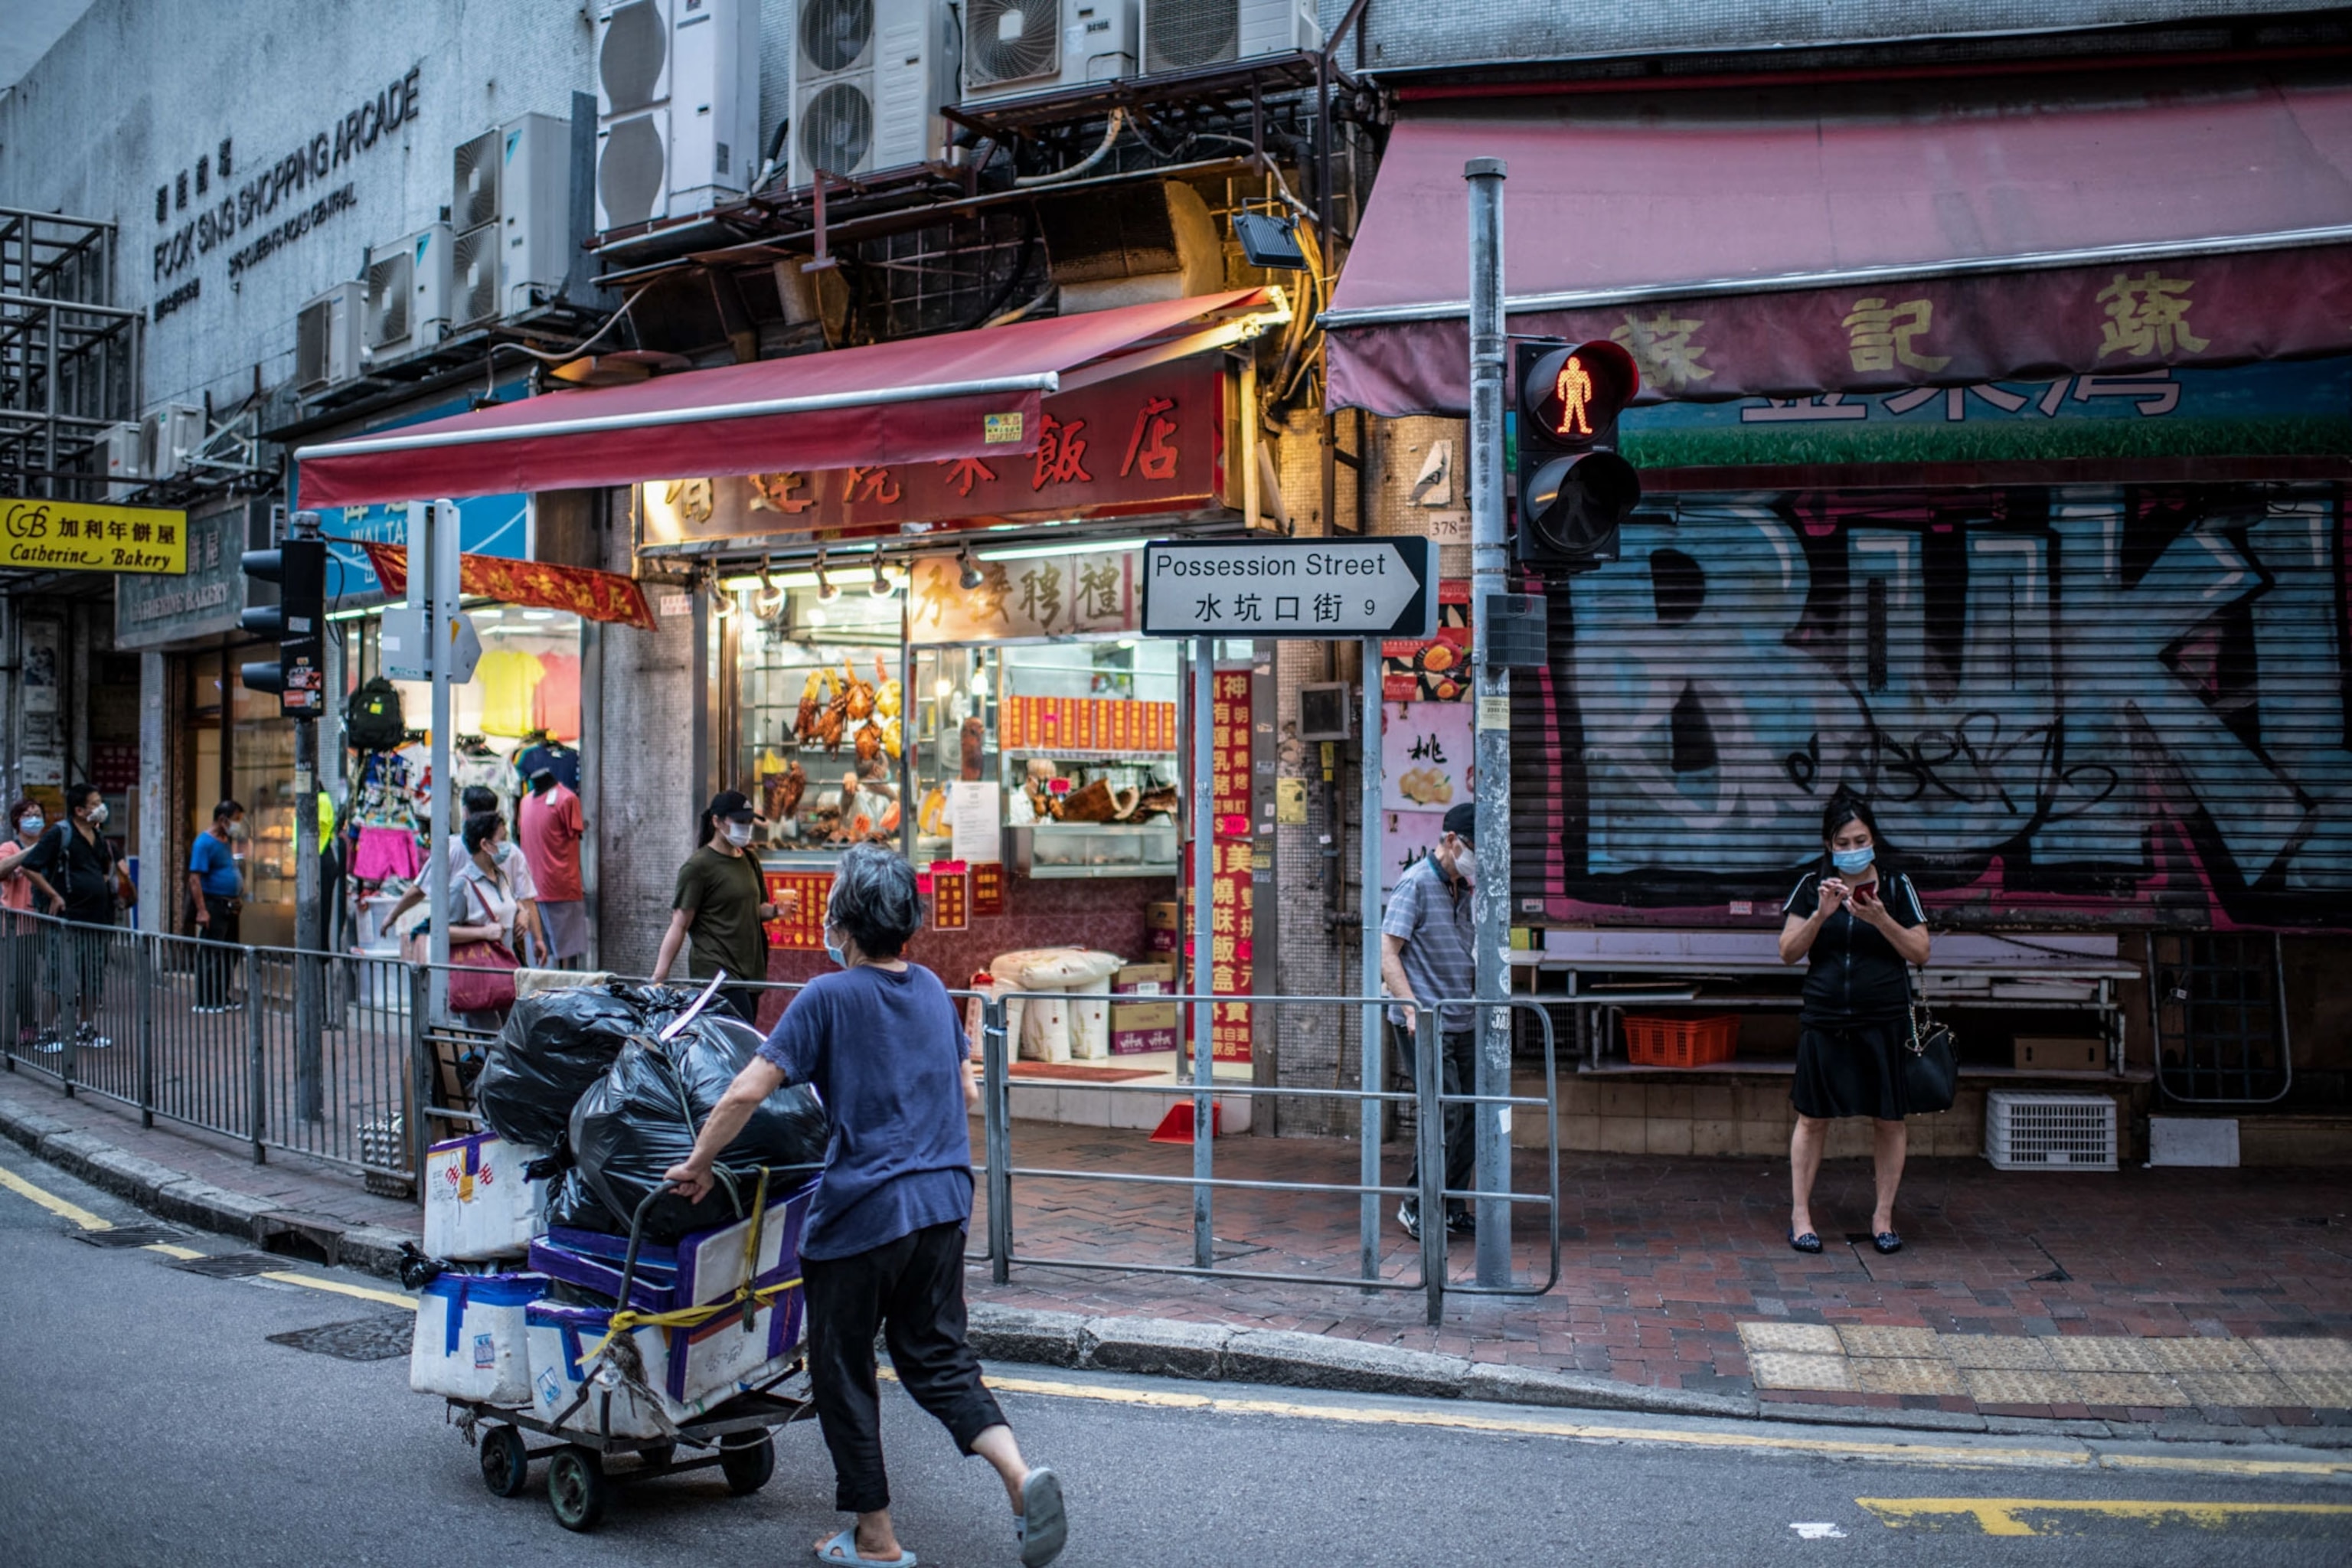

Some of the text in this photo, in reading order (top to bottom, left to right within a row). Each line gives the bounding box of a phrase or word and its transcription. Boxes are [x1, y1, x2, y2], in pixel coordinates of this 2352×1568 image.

[155, 221, 195, 283] FOOK
[197, 195, 235, 254] SING
[237, 132, 329, 229] SHOPPING
[332, 64, 420, 169] ARCADE
[57, 517, 176, 546] 加利年餅屋
[1432, 521, 1458, 536] 378
[10, 543, 171, 571] Catherine Bakery
[1156, 553, 1386, 577] Possession Street
[185, 581, 230, 612] BAKERY
[914, 557, 1125, 632] 承接聘禮
[1194, 593, 1375, 622] 水坑口街 9
[1407, 733, 1448, 763] 桃
[1212, 877, 1235, 992] 燒味飯盒
